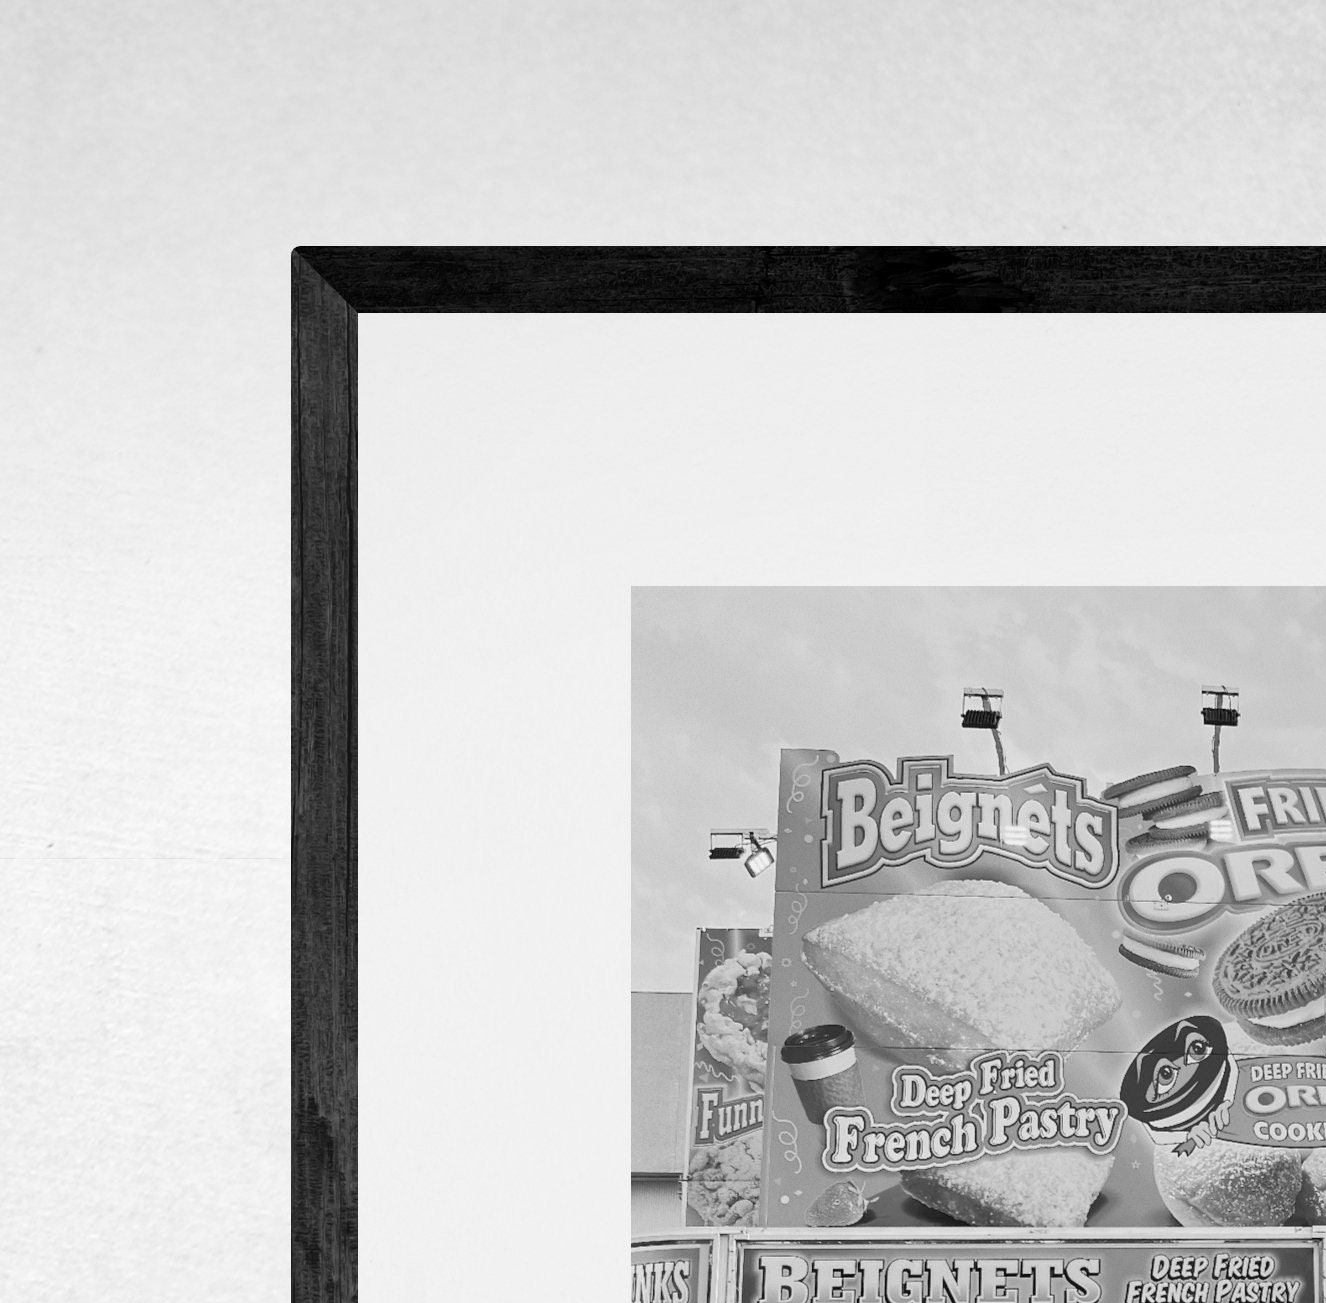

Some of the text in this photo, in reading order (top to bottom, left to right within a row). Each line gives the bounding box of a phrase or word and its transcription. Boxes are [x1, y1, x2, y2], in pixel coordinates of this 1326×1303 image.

[900, 1058, 1056, 1111] Deep Fried
[1250, 1063, 1293, 1083] DEEP
[830, 1096, 1119, 1164] French Pastry
[1150, 1252, 1276, 1281] DEEP FRIED
